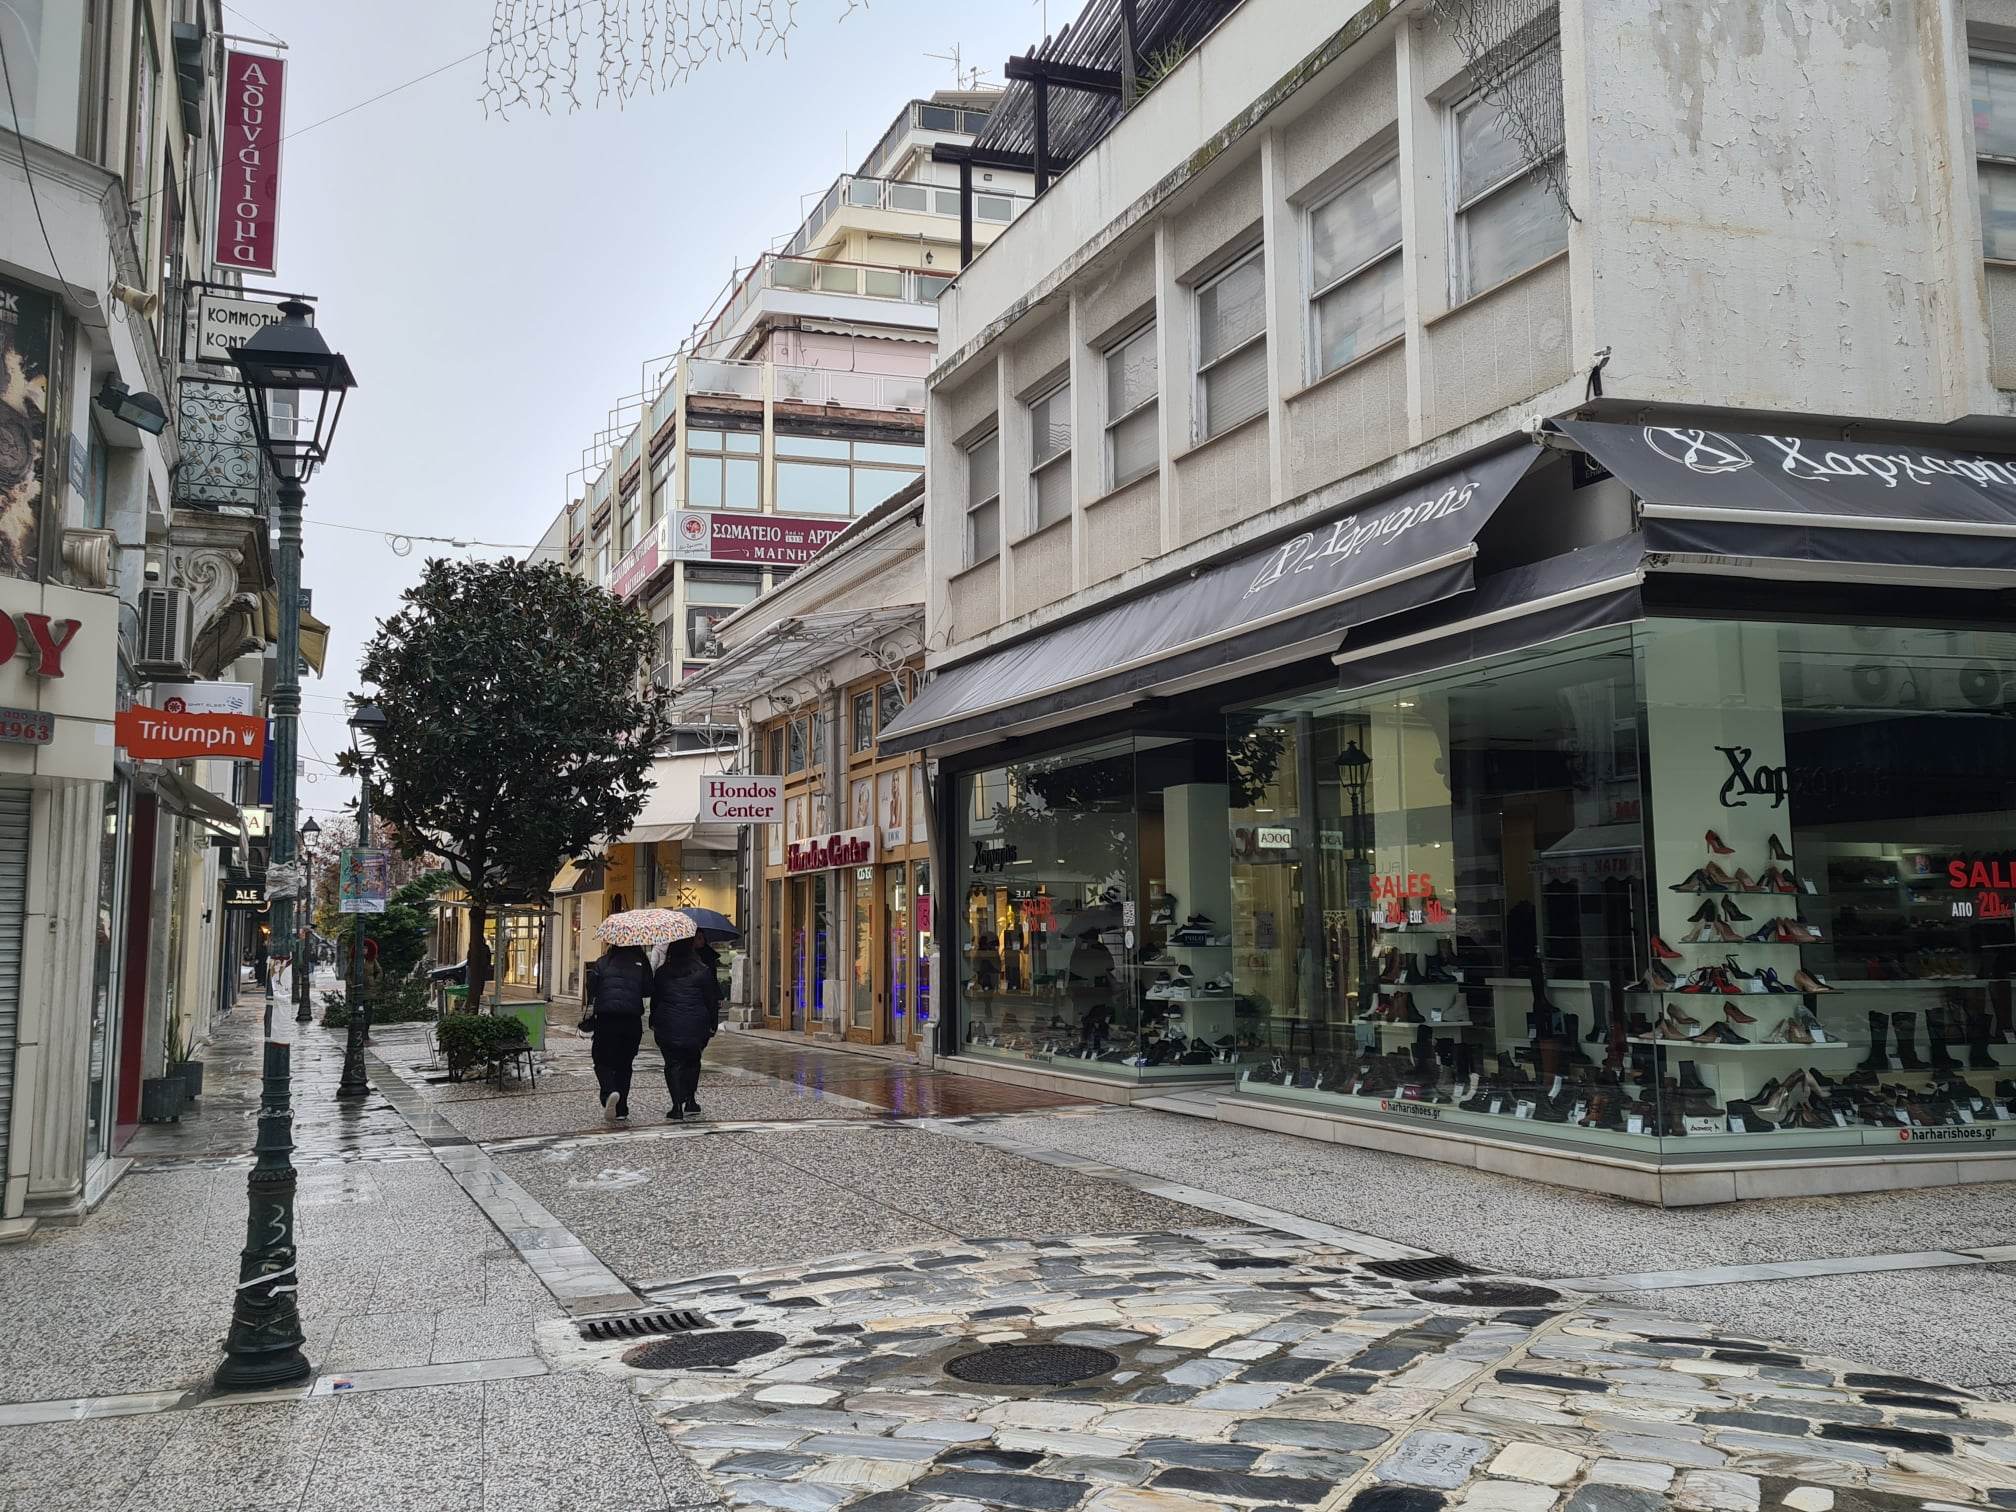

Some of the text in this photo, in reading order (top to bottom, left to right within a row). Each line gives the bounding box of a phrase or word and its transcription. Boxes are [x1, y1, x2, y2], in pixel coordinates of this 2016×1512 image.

[233, 62, 269, 263] Αδυνάτισμα
[208, 307, 286, 327] ΚΟΜΜΩΤΗ
[712, 523, 781, 542] ΣΩΜΑΤΕΙΟ
[138, 720, 236, 748] Triumph
[709, 782, 777, 799] Hondos
[712, 801, 774, 818] Center
[788, 835, 870, 872] Hondos Center
[235, 890, 258, 900] ALE
[1369, 872, 1433, 902] SALES
[1371, 911, 1385, 924] ΑΠΟ
[1951, 902, 1973, 917] ΑΠΟ
[1388, 1102, 1440, 1120] harharishoes.gr
[1911, 1127, 1997, 1140] harharishoes.gr
